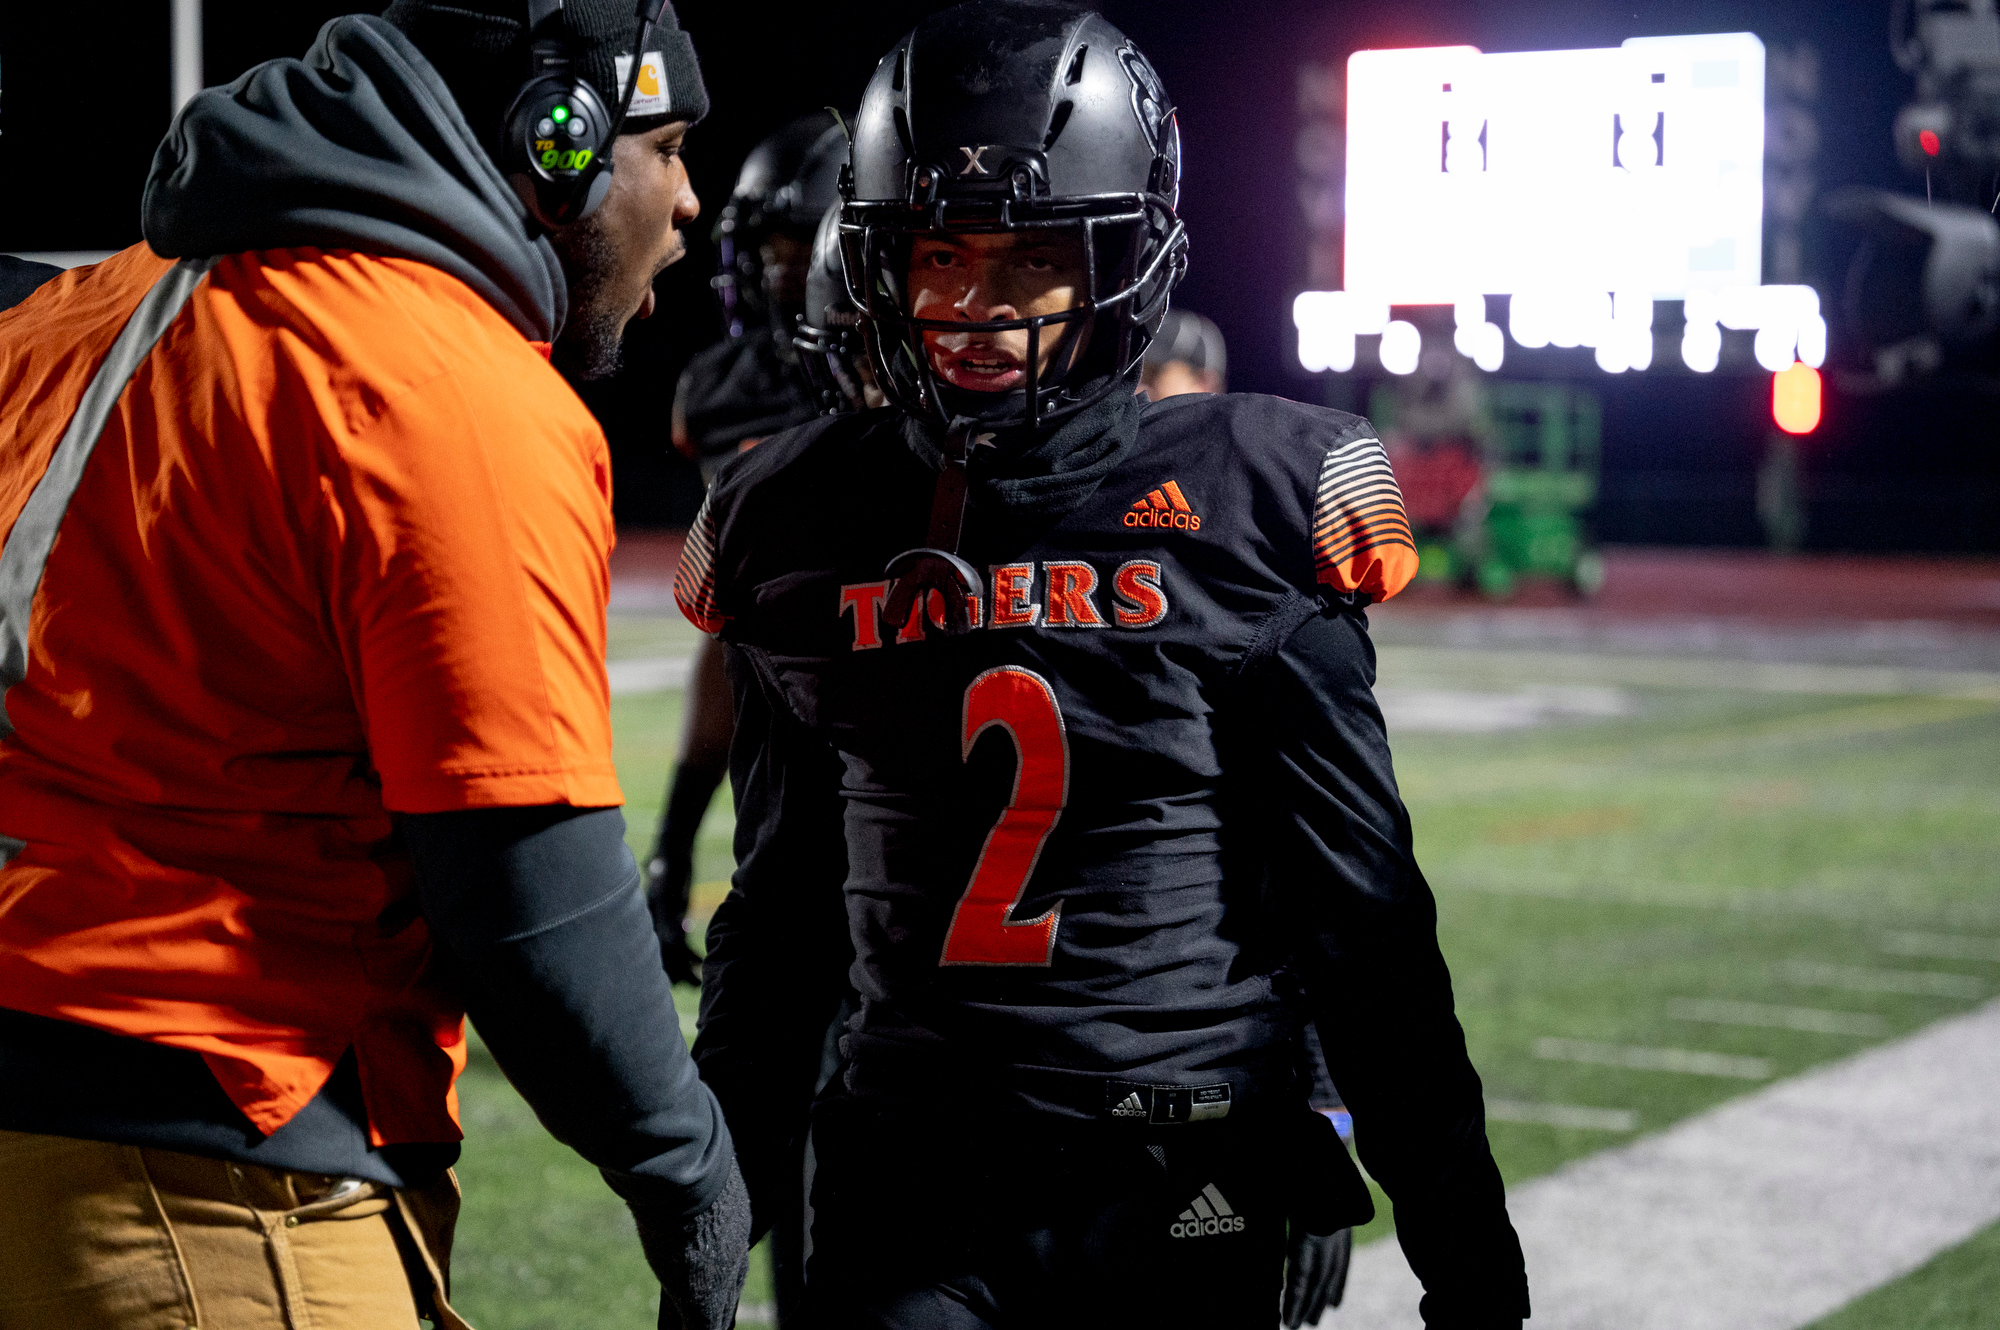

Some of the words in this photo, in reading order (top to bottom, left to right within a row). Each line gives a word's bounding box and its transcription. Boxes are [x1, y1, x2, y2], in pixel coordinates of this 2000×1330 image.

[541, 149, 593, 170] 900
[959, 146, 988, 175] X
[1123, 507, 1201, 531] adidas
[938, 664, 1071, 967] 2
[1111, 1107, 1147, 1117] adidas
[1170, 1215, 1246, 1239] adidas
